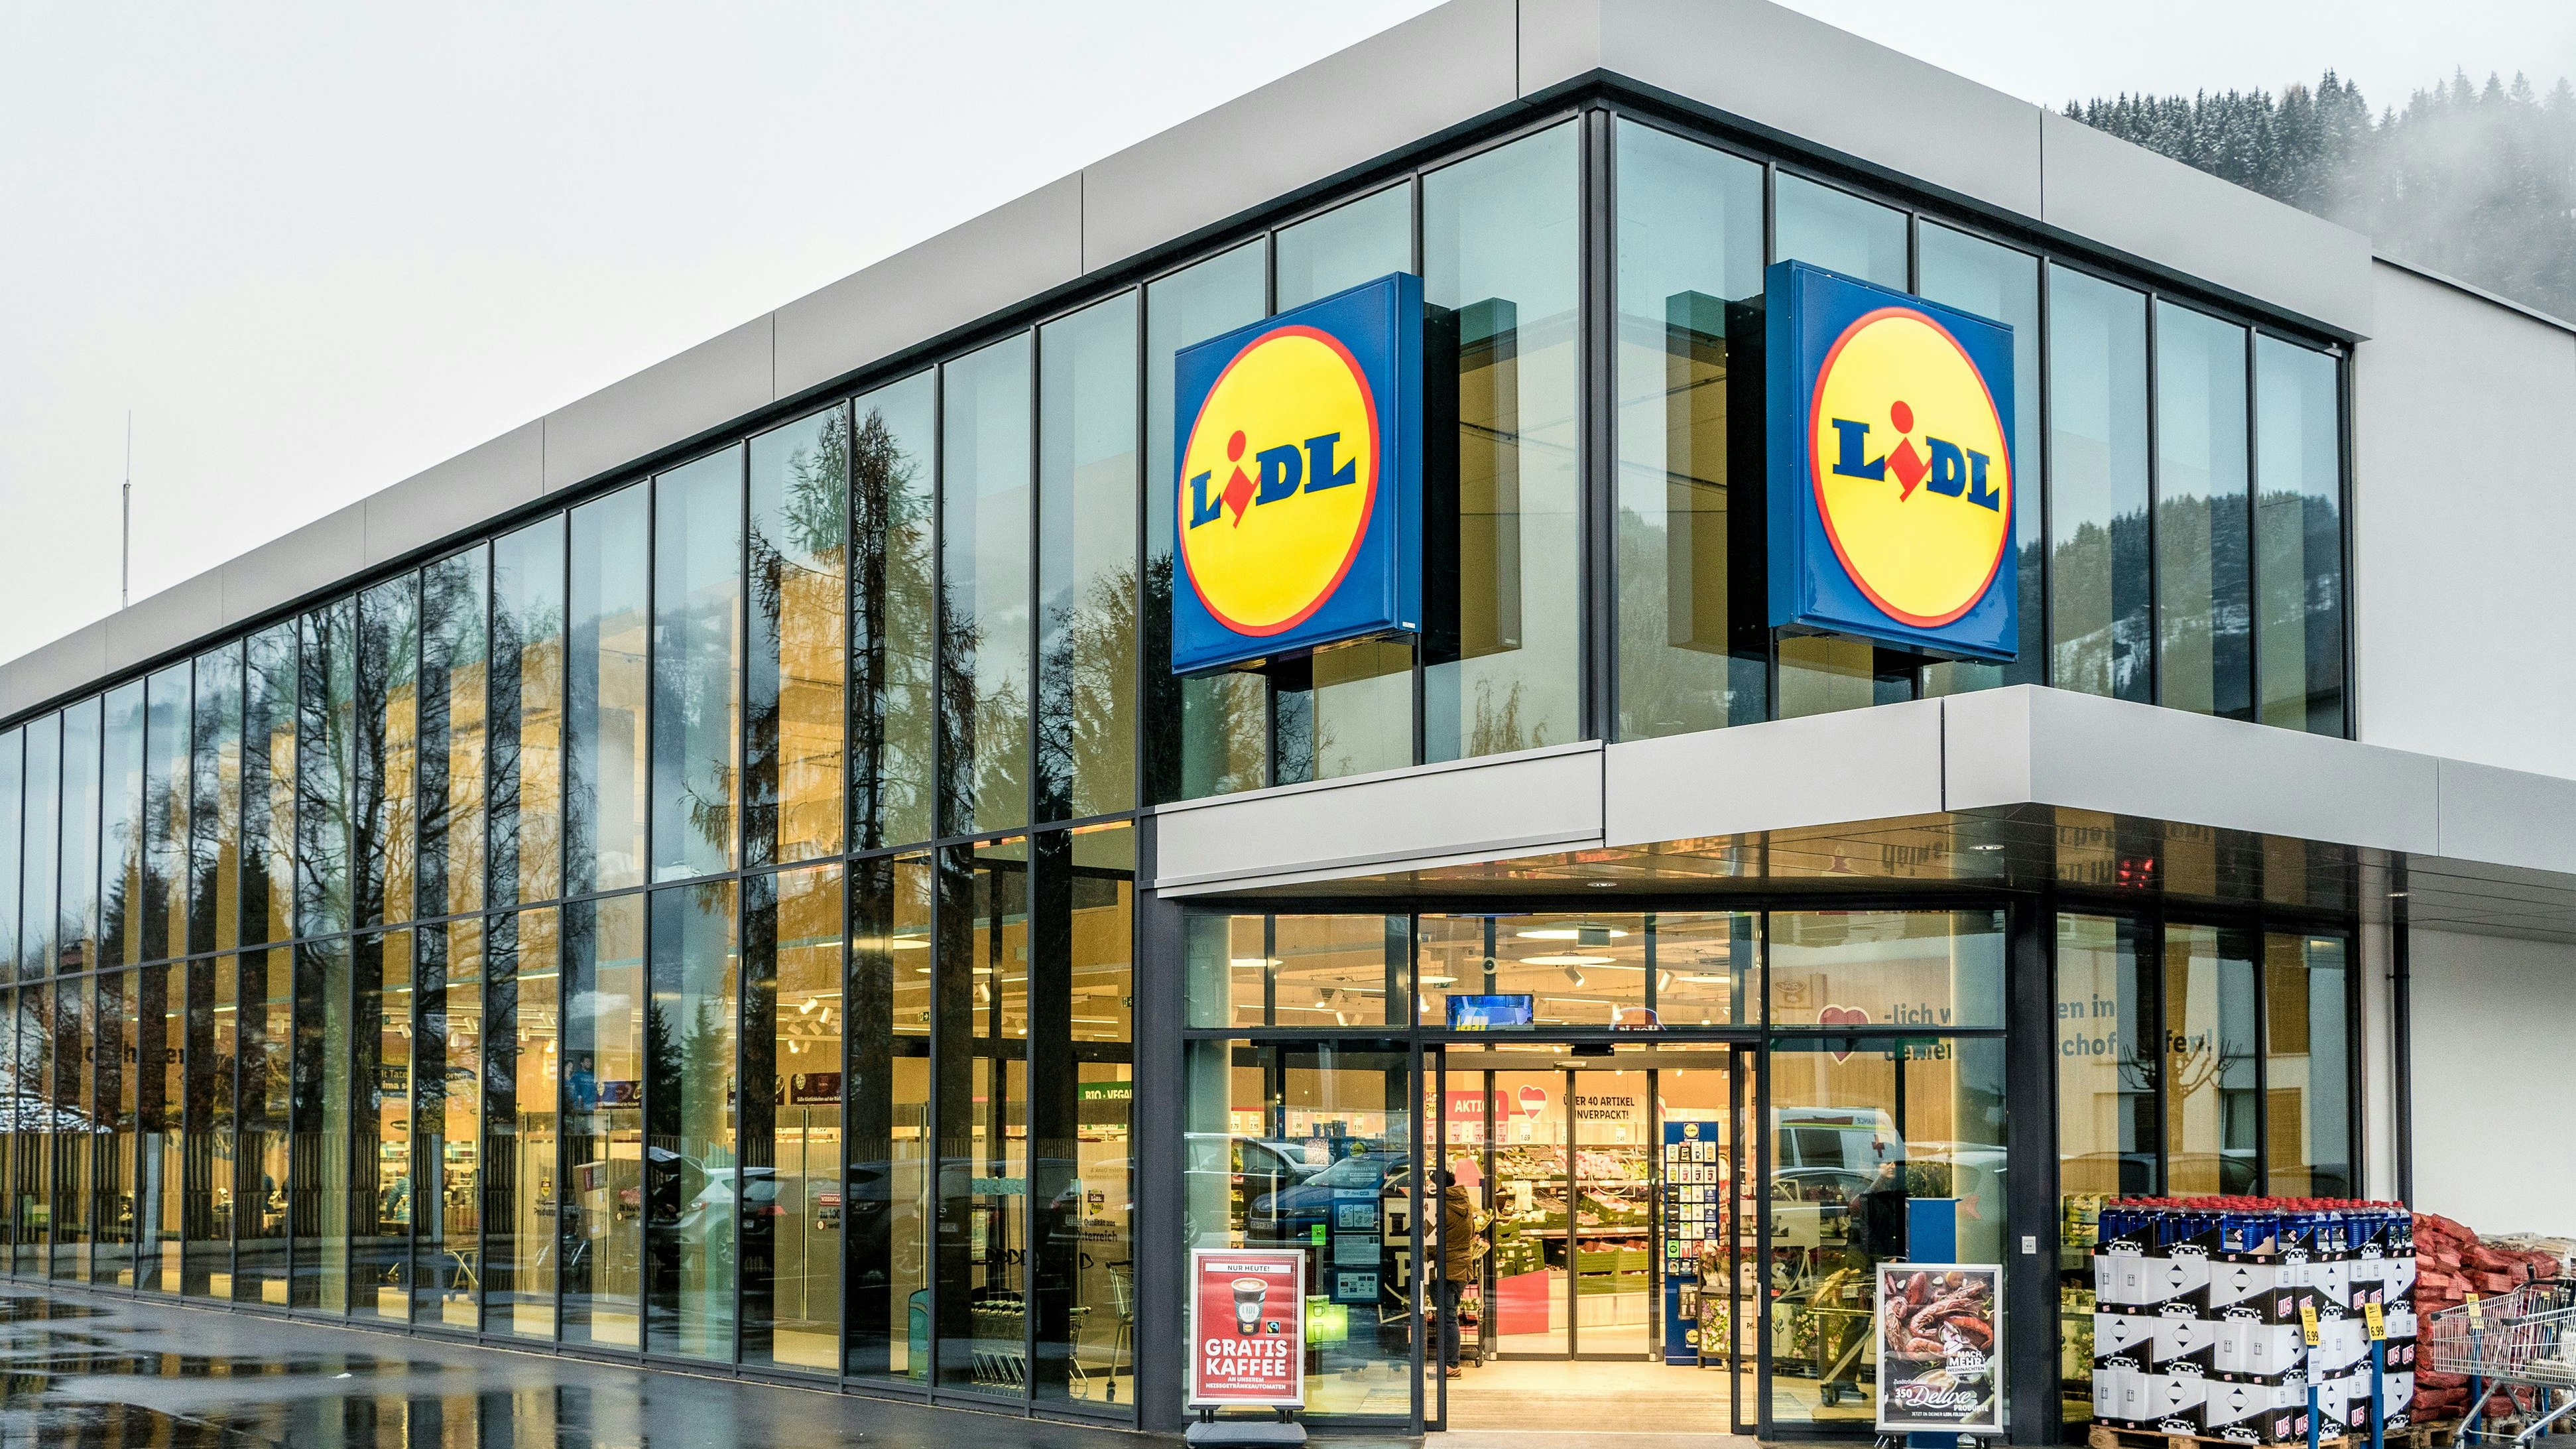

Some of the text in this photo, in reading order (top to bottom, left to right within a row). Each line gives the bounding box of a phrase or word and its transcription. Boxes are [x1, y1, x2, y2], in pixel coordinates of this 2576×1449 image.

[2092, 993, 2115, 1018] in
[1564, 1094, 1635, 1106] ÜER 40 ARTIKEL
[1454, 1100, 1499, 1113] AKTIN
[1575, 1109, 1629, 1119] NVERPACKT!
[2306, 1330, 2319, 1342] 6.99
[2370, 1326, 2384, 1337] 6.99
[1205, 1338, 1288, 1357] GRATIS
[1205, 1357, 1286, 1377] KAFFEE
[1949, 1357, 1981, 1367] MEHR
[1895, 1385, 1971, 1409] 350 Deluxe
